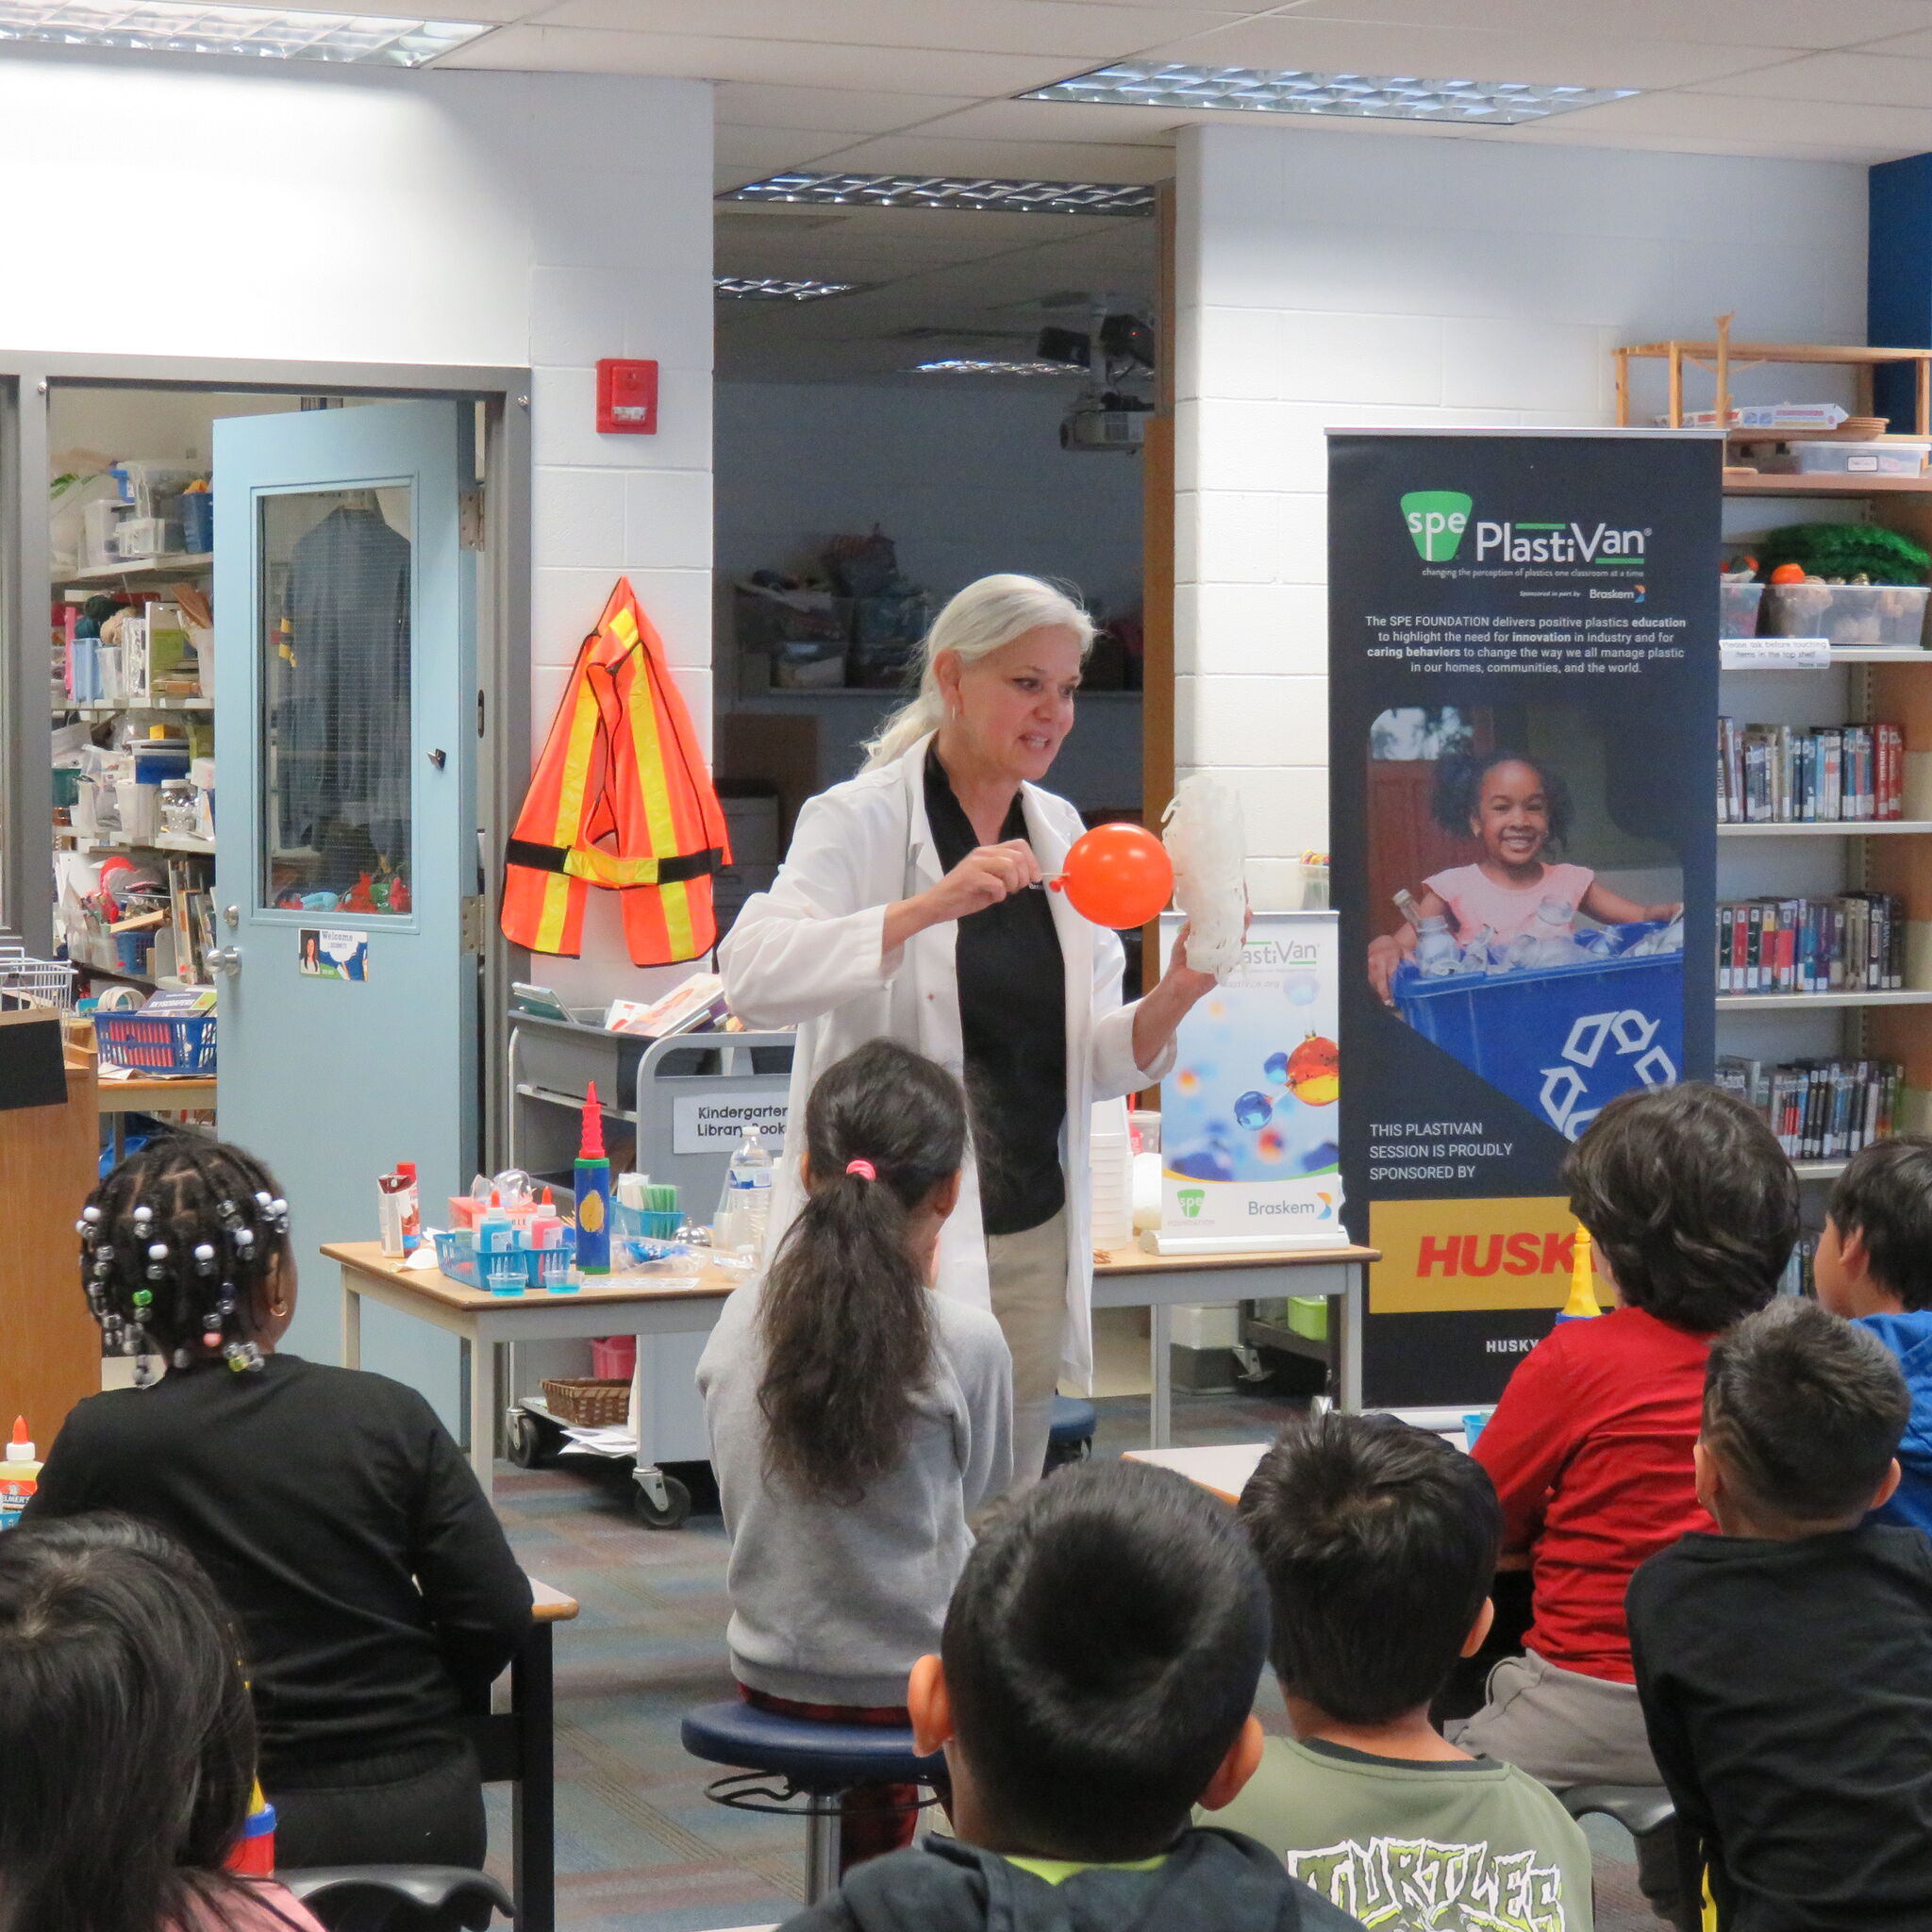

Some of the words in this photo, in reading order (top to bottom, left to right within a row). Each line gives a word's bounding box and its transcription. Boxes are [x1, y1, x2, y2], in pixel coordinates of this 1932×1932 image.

[1408, 510, 1467, 561] spe
[1422, 568, 1457, 579] changing
[1458, 568, 1471, 576] the
[1473, 568, 1513, 579] perception
[1515, 568, 1524, 576] of
[1524, 568, 1553, 579] plastics
[1571, 569, 1608, 577] classroom
[1626, 569, 1644, 577] time
[1589, 588, 1635, 599] Braskem
[1365, 615, 1386, 627] The
[1389, 615, 1411, 627] SPE
[1415, 615, 1490, 627] FOUNDATION
[1491, 615, 1535, 627] delivers
[1539, 616, 1582, 630] positive
[1585, 616, 1628, 630] plastics
[1631, 616, 1686, 628] education
[1377, 631, 1390, 642] to
[1392, 630, 1441, 645] highlight
[1444, 630, 1461, 642] the
[1464, 631, 1490, 642] need
[1493, 630, 1509, 642] for
[1512, 631, 1571, 642] innovation
[1574, 631, 1584, 642] in
[1587, 631, 1631, 645] industry
[1634, 631, 1655, 642] and
[1658, 631, 1674, 642] for
[1366, 646, 1403, 660] caring
[1406, 645, 1460, 658] behaviors
[1463, 647, 1474, 658] to
[1476, 645, 1517, 660] change
[1520, 646, 1538, 658] the
[1541, 648, 1562, 660] way
[1565, 649, 1581, 658] we
[1584, 646, 1597, 658] all
[1600, 649, 1644, 660] manage
[1647, 646, 1684, 660] plastic
[1410, 661, 1421, 673] in
[1424, 663, 1442, 673] our
[1444, 661, 1484, 675] homes,
[1487, 661, 1561, 675] communities,
[1563, 661, 1585, 673] and
[1587, 661, 1605, 673] the
[1607, 661, 1641, 673] world.
[1243, 941, 1318, 964] astiVan
[751, 1122, 786, 1136] ook
[1369, 1124, 1403, 1137] THIS
[1406, 1122, 1483, 1136] PLASTIVAN
[1369, 1145, 1429, 1158] SESSION
[1432, 1143, 1445, 1158] IS
[1448, 1142, 1512, 1157] PROUDLY
[1369, 1166, 1454, 1180] SPONSORED
[1457, 1165, 1475, 1178] BY
[1248, 1201, 1315, 1215] Braskem
[1416, 1232, 1598, 1277] HUSK
